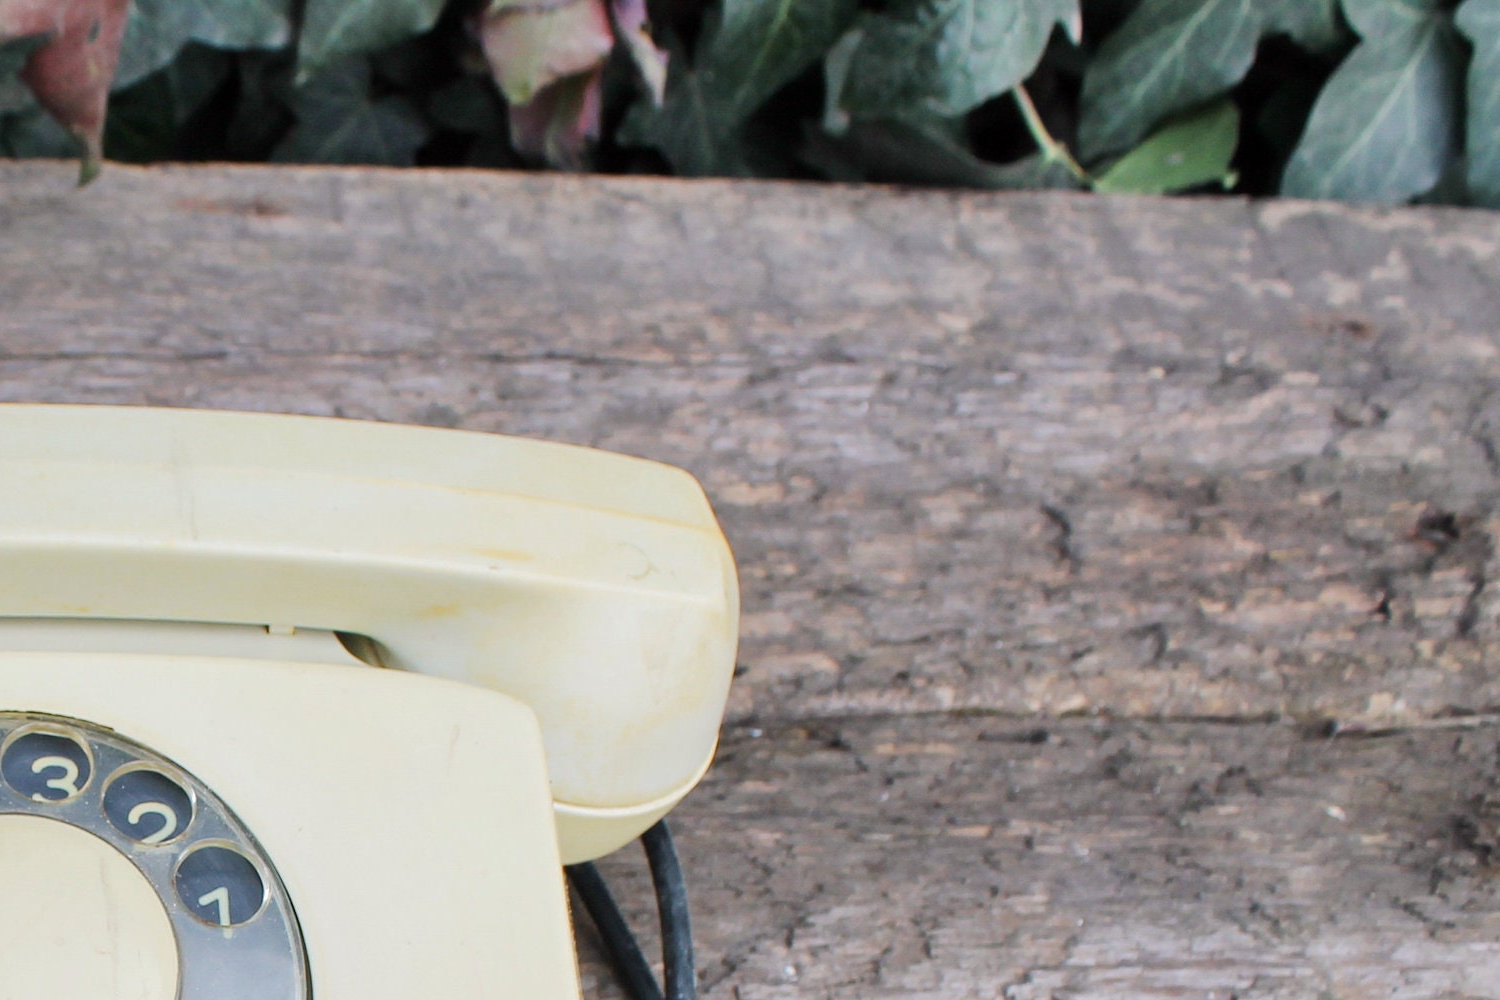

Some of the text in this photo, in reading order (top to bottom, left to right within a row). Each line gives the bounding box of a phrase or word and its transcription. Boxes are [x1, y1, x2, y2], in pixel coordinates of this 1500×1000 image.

[31, 756, 79, 803] 3
[127, 802, 179, 851] 2
[198, 886, 234, 939] 1
